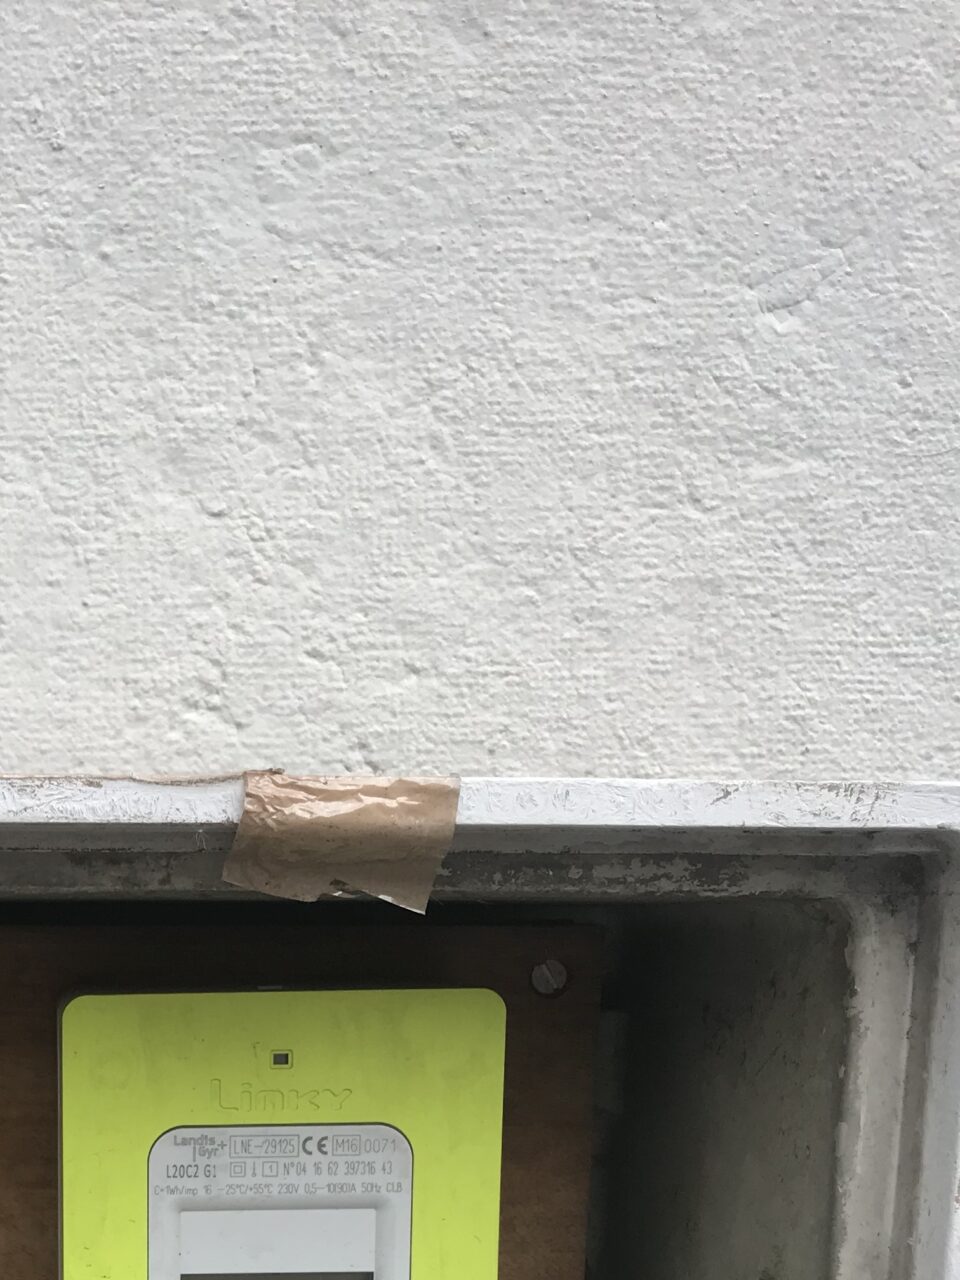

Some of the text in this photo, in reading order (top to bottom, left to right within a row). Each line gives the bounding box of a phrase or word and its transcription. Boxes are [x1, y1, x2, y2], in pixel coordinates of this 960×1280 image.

[335, 1139, 358, 1153] M16
[363, 1138, 397, 1154] 0071
[166, 1164, 217, 1179] L20C2 G1
[327, 1161, 339, 1176] 62
